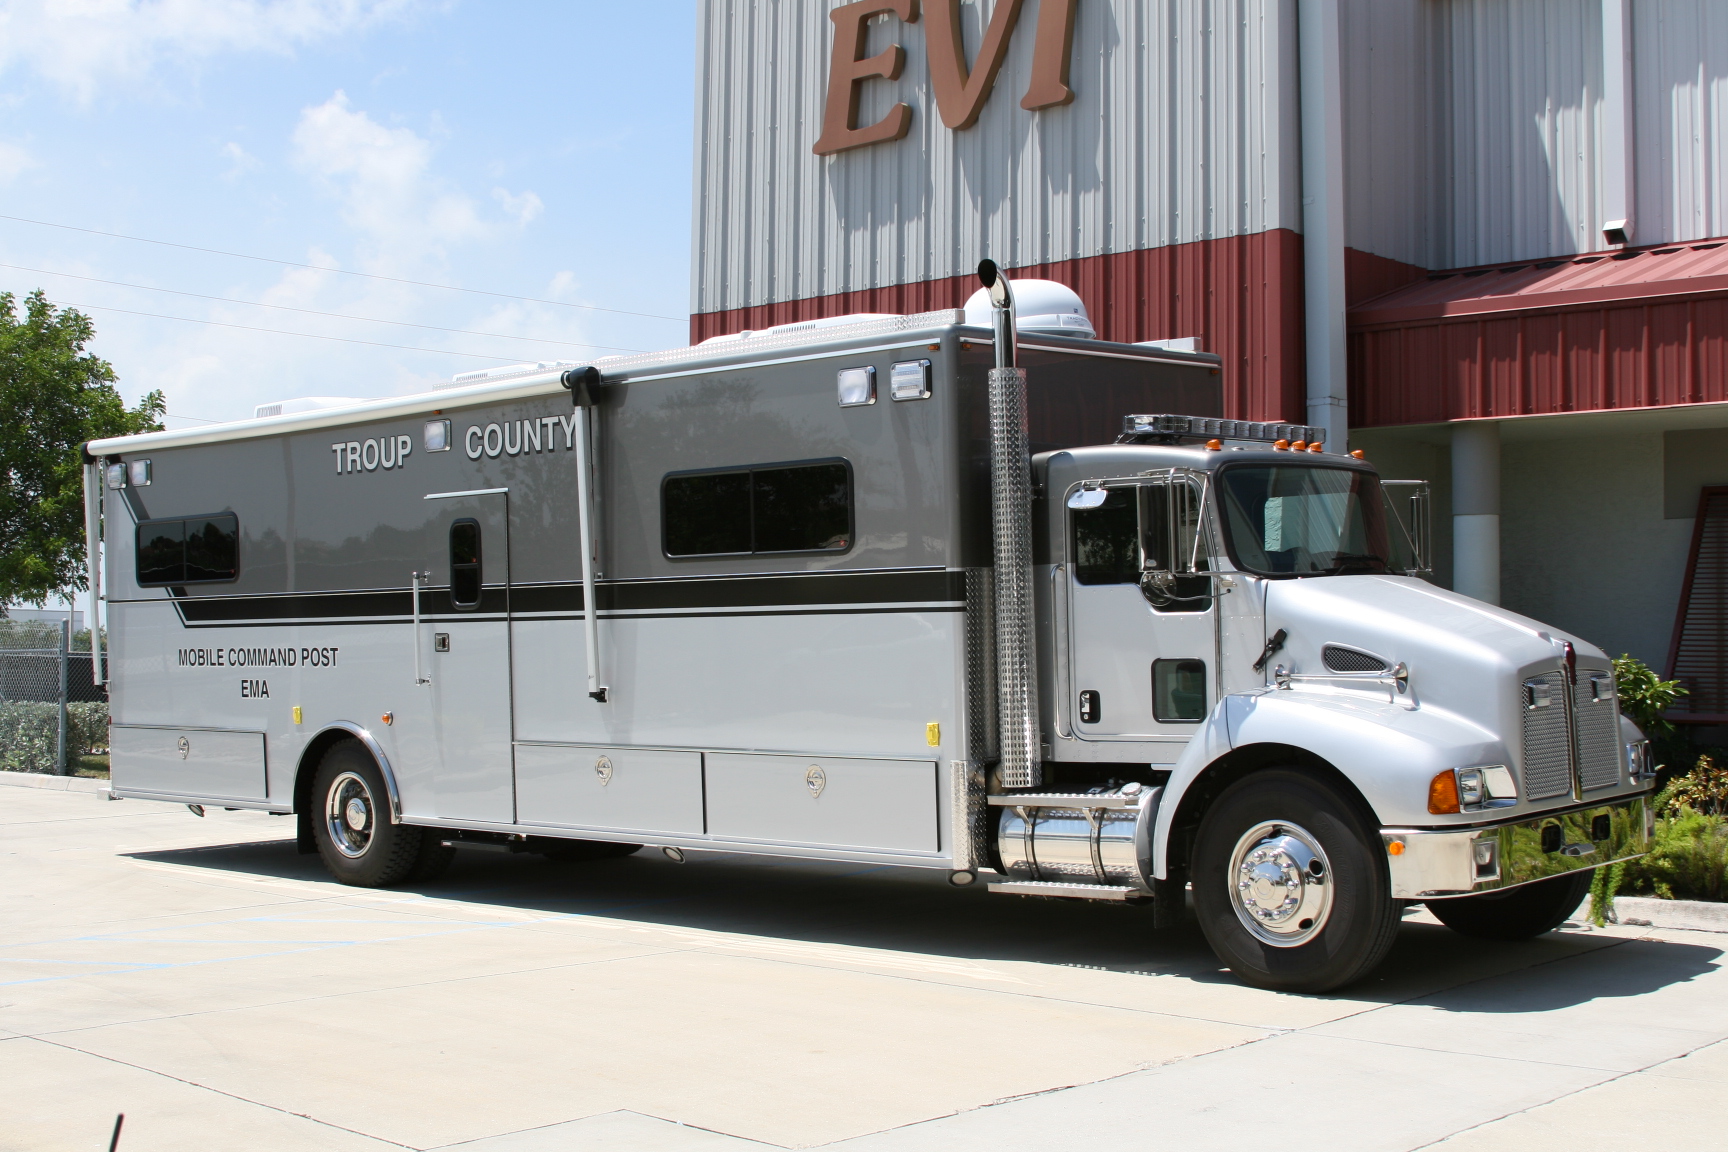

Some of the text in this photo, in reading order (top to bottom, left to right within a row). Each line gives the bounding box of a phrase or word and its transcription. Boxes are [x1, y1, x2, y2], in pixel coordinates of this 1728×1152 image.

[812, 0, 1075, 156] EVI
[332, 413, 576, 475] TROUP COUNTY
[178, 647, 339, 667] MOBILE COMMAND POST
[241, 679, 270, 699] EMA
